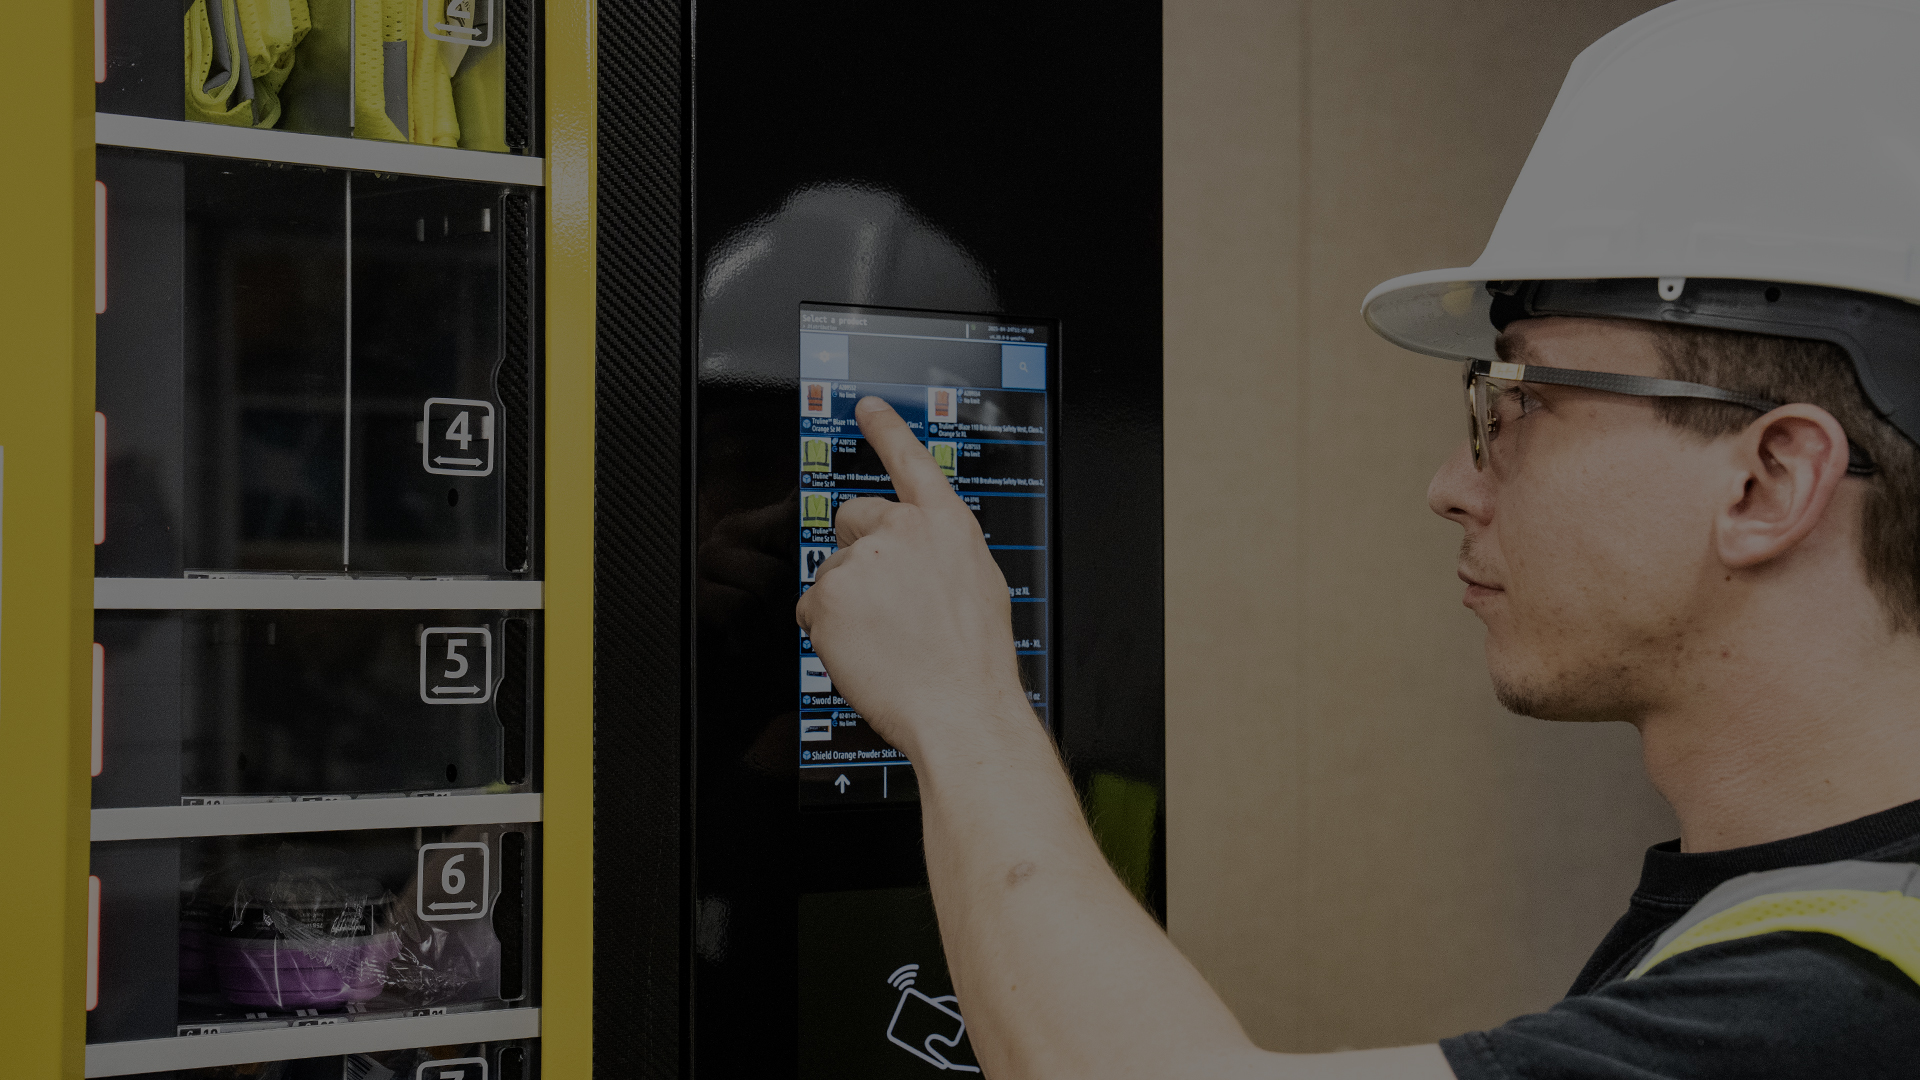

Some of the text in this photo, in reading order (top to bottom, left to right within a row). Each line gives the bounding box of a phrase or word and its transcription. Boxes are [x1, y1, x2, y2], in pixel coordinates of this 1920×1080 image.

[803, 314, 828, 324] Select
[839, 318, 868, 326] product
[446, 411, 472, 451] 4
[812, 426, 829, 434] Orange
[958, 423, 970, 431] Blaze
[979, 424, 1002, 433] Breakaway
[1002, 425, 1016, 434] Safety
[938, 430, 955, 438] Orange
[855, 474, 880, 482] Breakaway
[979, 477, 1002, 486] Breakaway
[1002, 478, 1016, 486] Safety
[1022, 586, 1030, 596] XL
[1033, 639, 1042, 648] XL
[444, 639, 468, 679] 5
[812, 696, 832, 705] Sword
[812, 750, 832, 760] Shield
[833, 751, 857, 761] Orange
[858, 749, 881, 760] Powder
[882, 748, 897, 758] Stick
[442, 854, 466, 895] 6
